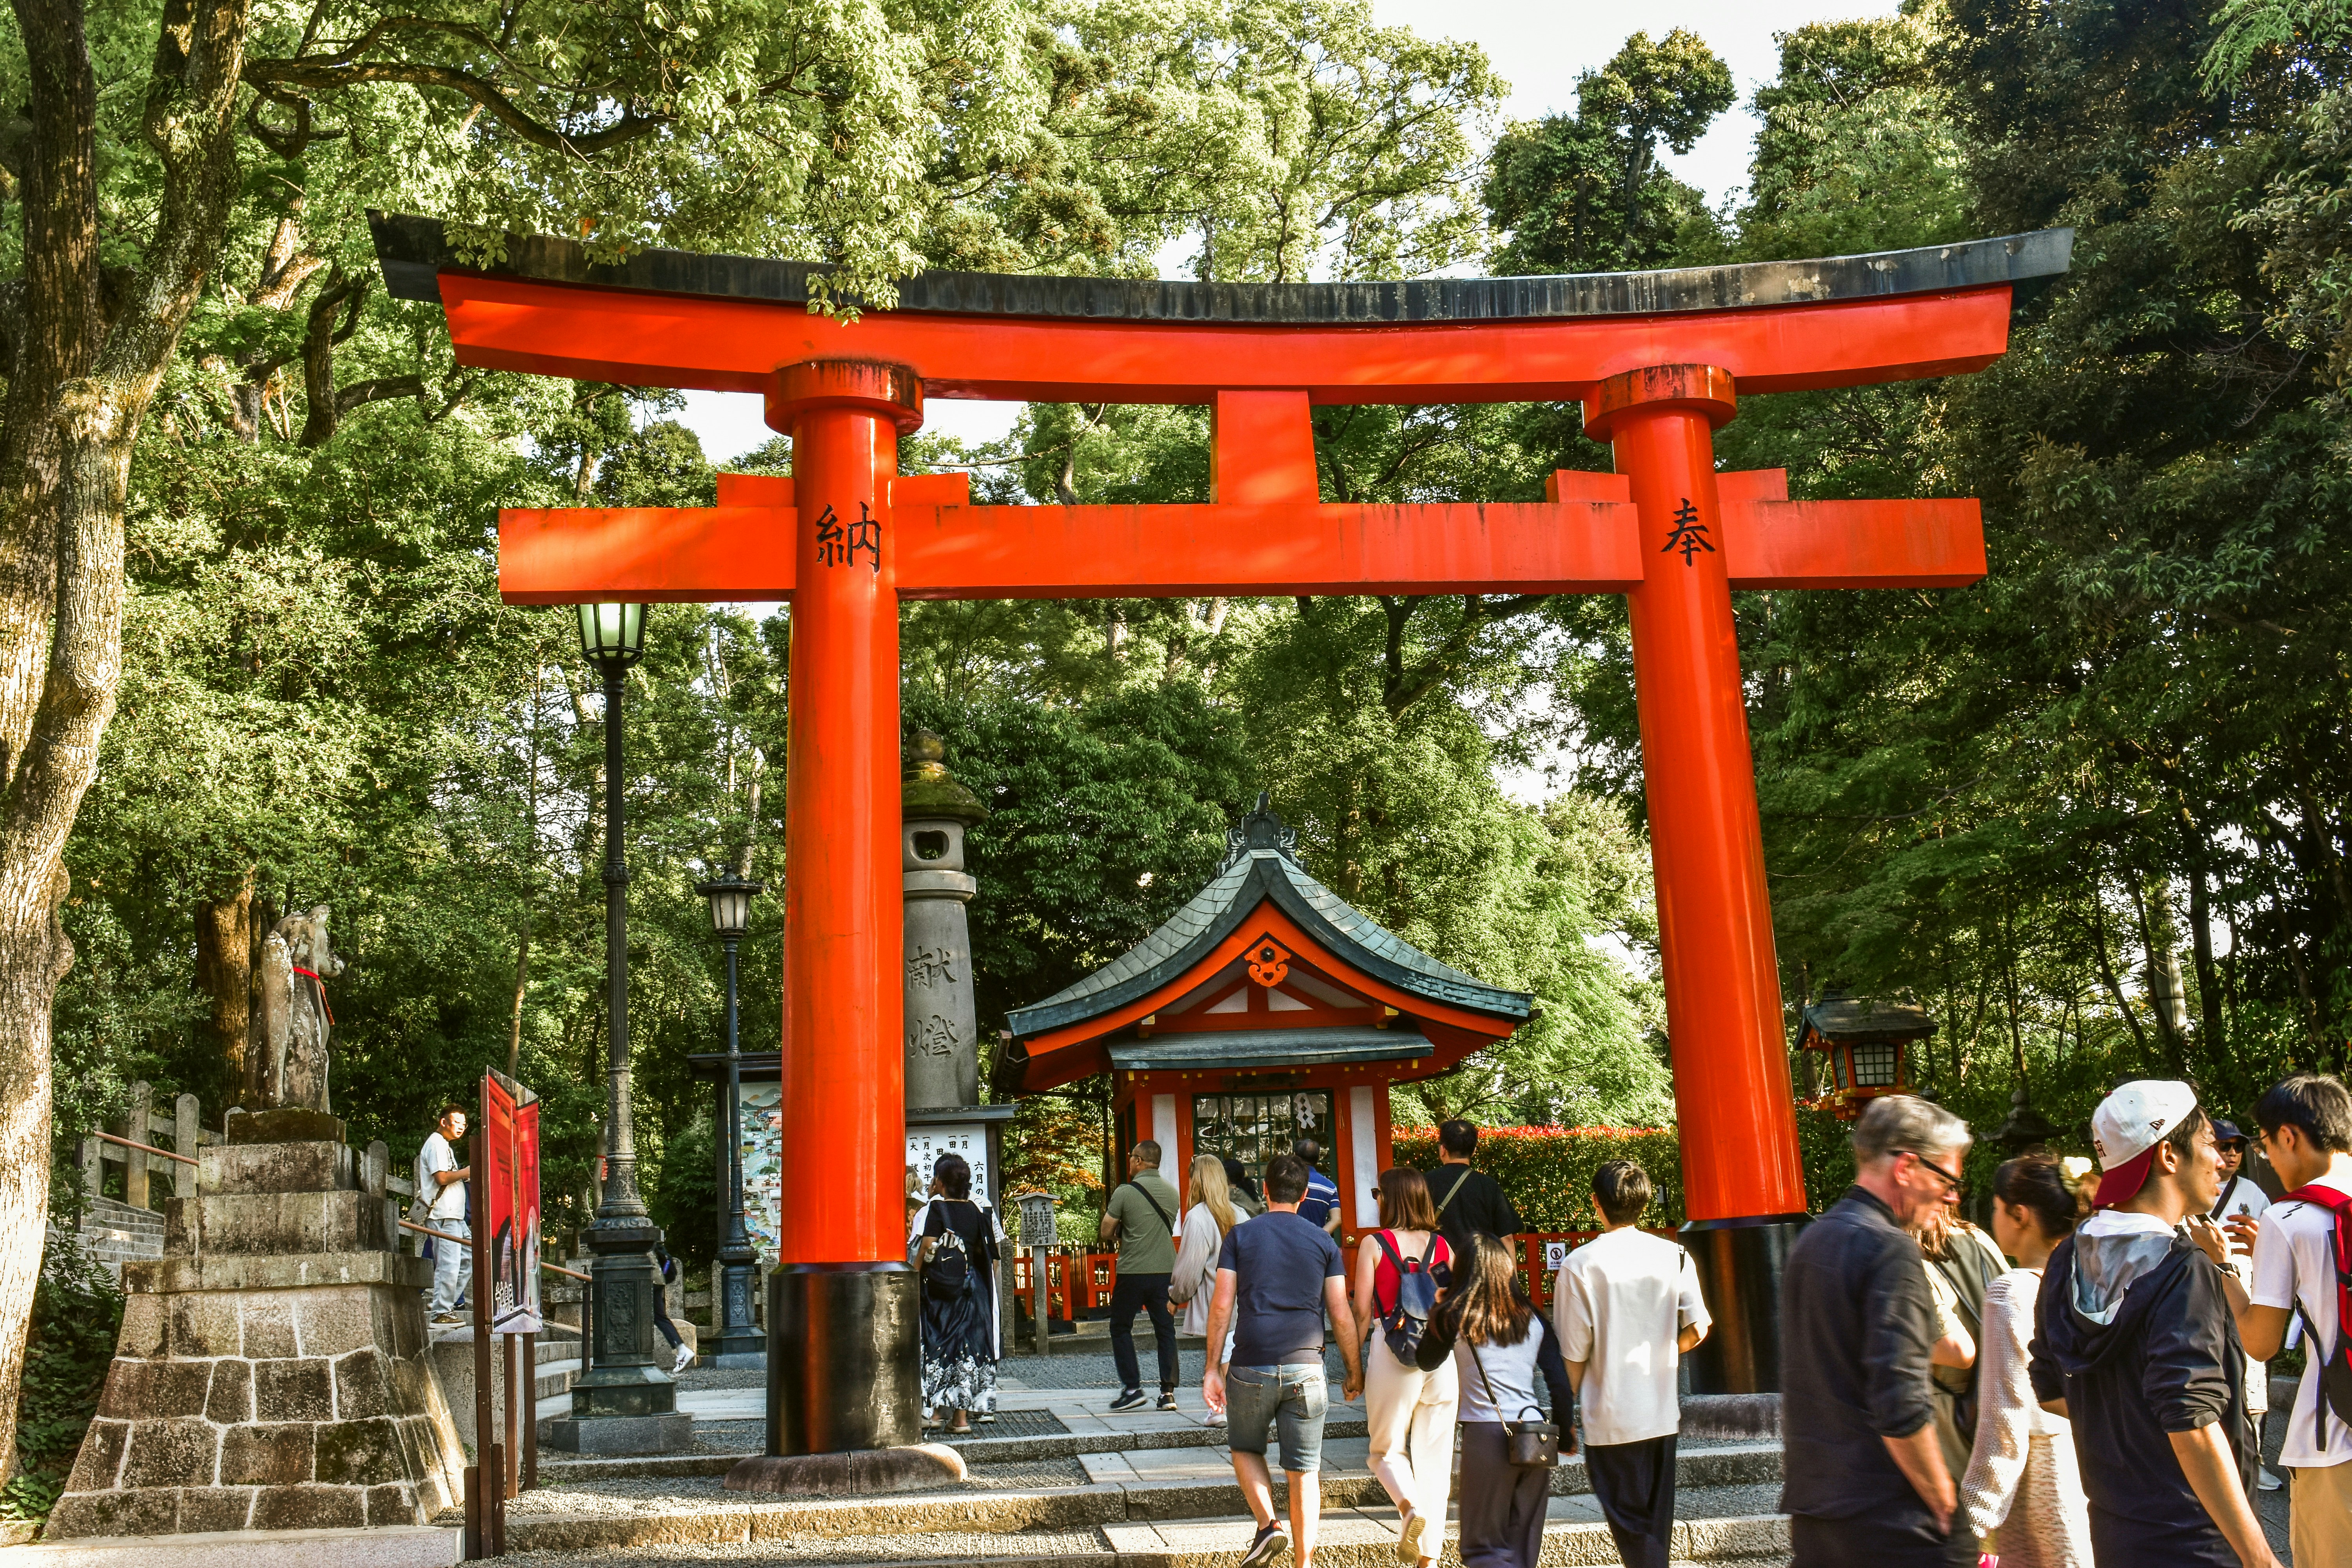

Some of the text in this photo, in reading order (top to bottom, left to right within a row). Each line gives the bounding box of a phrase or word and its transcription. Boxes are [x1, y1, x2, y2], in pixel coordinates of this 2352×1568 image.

[816, 501, 882, 573] 納
[1661, 497, 1716, 567] 奉
[974, 1161, 984, 1196] 六月の
